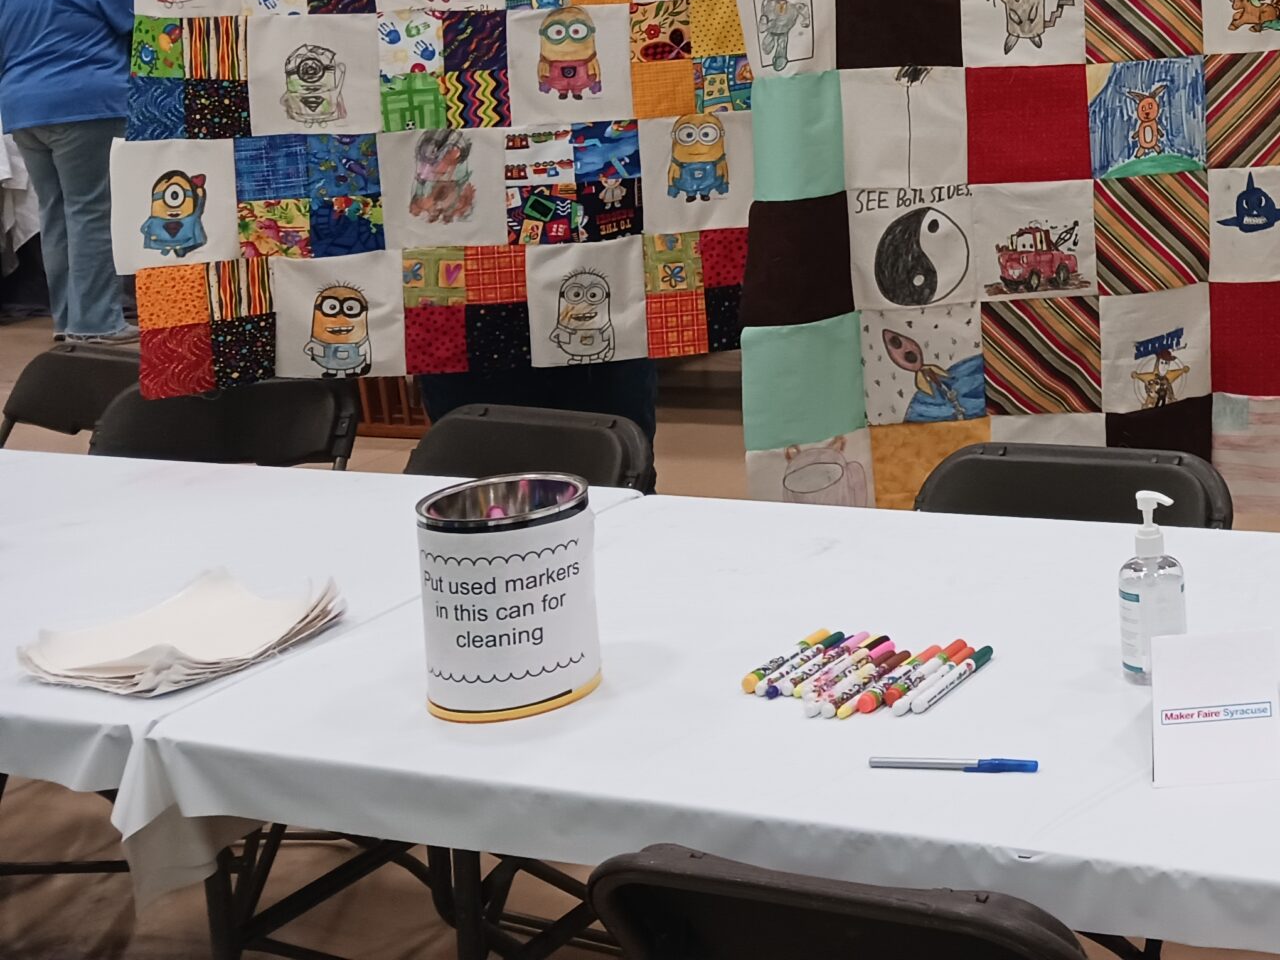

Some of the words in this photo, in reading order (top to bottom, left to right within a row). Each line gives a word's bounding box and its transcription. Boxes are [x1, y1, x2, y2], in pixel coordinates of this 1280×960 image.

[855, 190, 889, 213] SEE
[424, 570, 443, 593] Put
[449, 577, 496, 595] used
[505, 560, 580, 593] markers
[435, 600, 448, 619] in
[454, 604, 488, 622] this
[496, 602, 534, 621] can
[541, 592, 566, 612] for
[456, 626, 544, 648] cleaning
[1164, 710, 1195, 721] Maker
[1197, 708, 1221, 719] Faire
[1223, 704, 1268, 718] Syracuse
